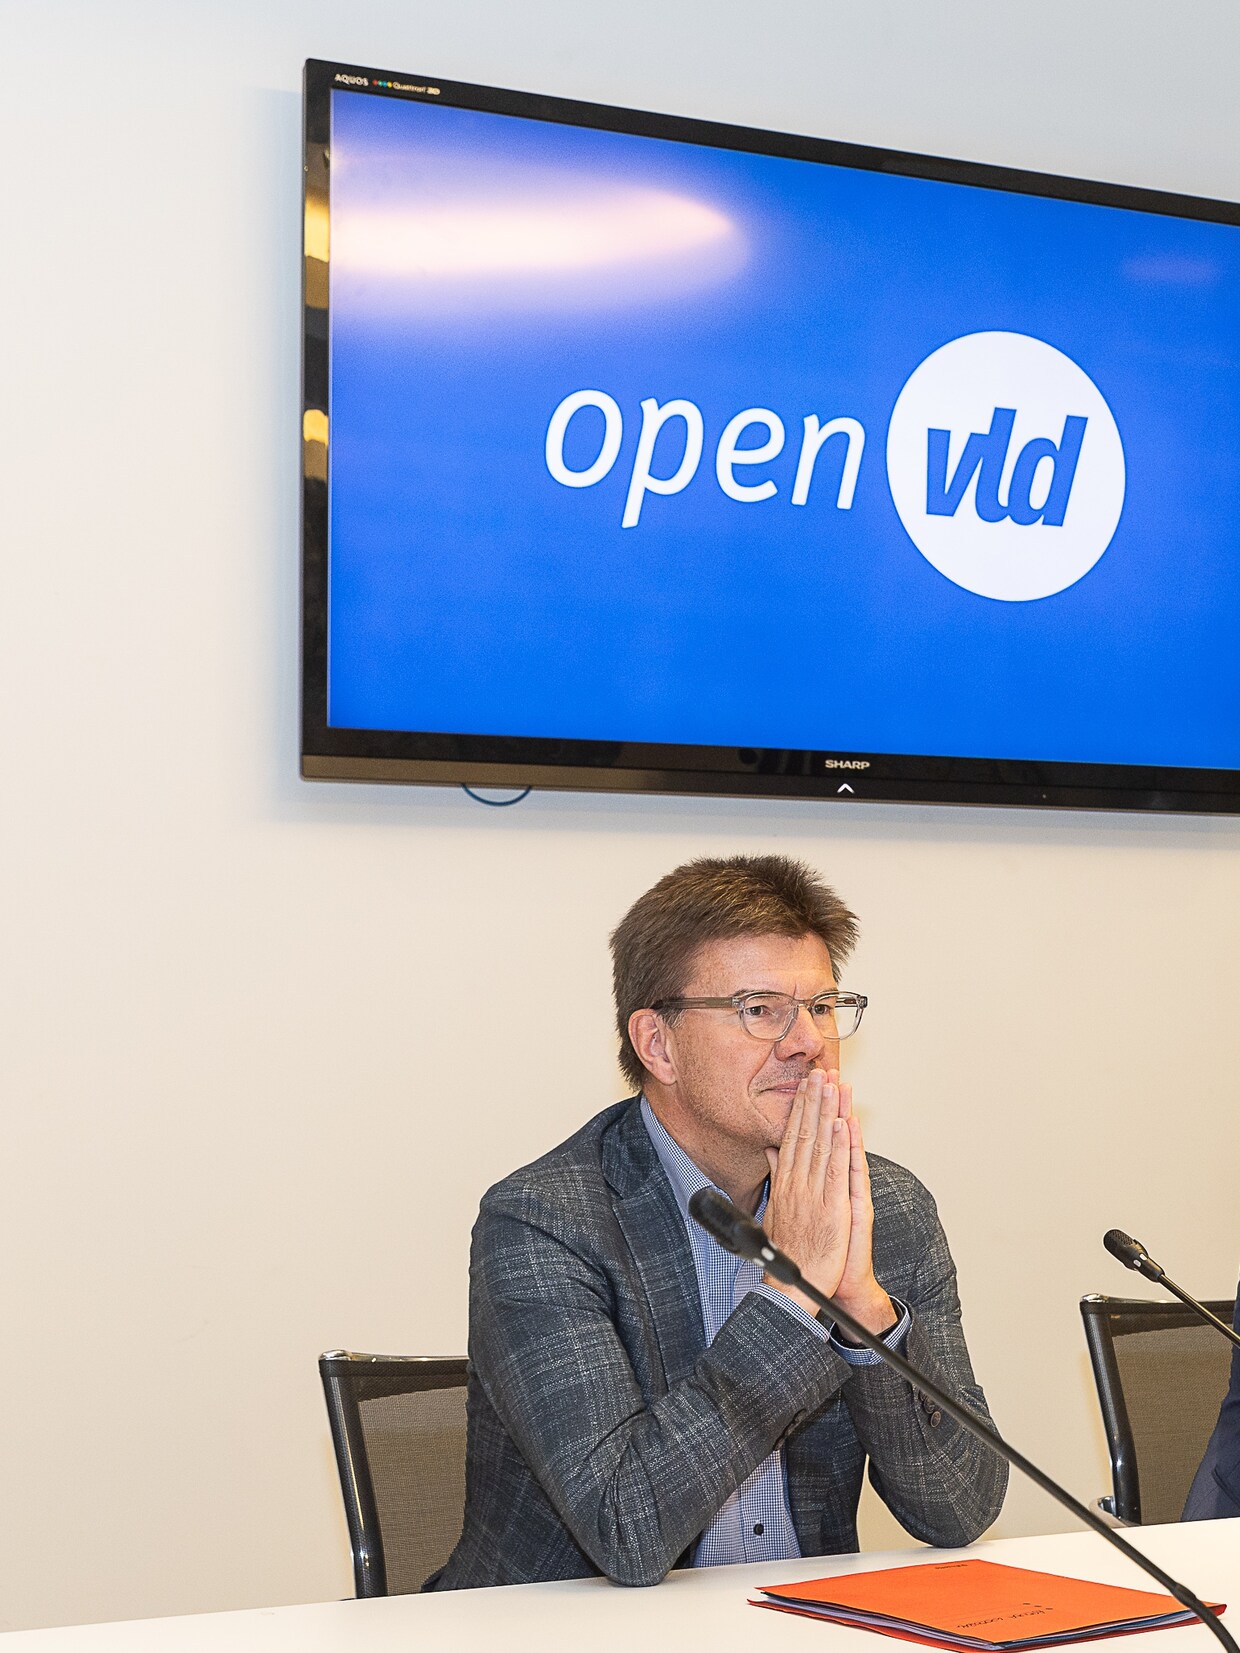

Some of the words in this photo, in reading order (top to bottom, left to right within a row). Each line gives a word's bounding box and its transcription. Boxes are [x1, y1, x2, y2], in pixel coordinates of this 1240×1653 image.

[334, 73, 369, 87] AQUOS
[544, 388, 867, 530] open
[925, 405, 1090, 528] vld
[825, 759, 871, 770] SHARP
